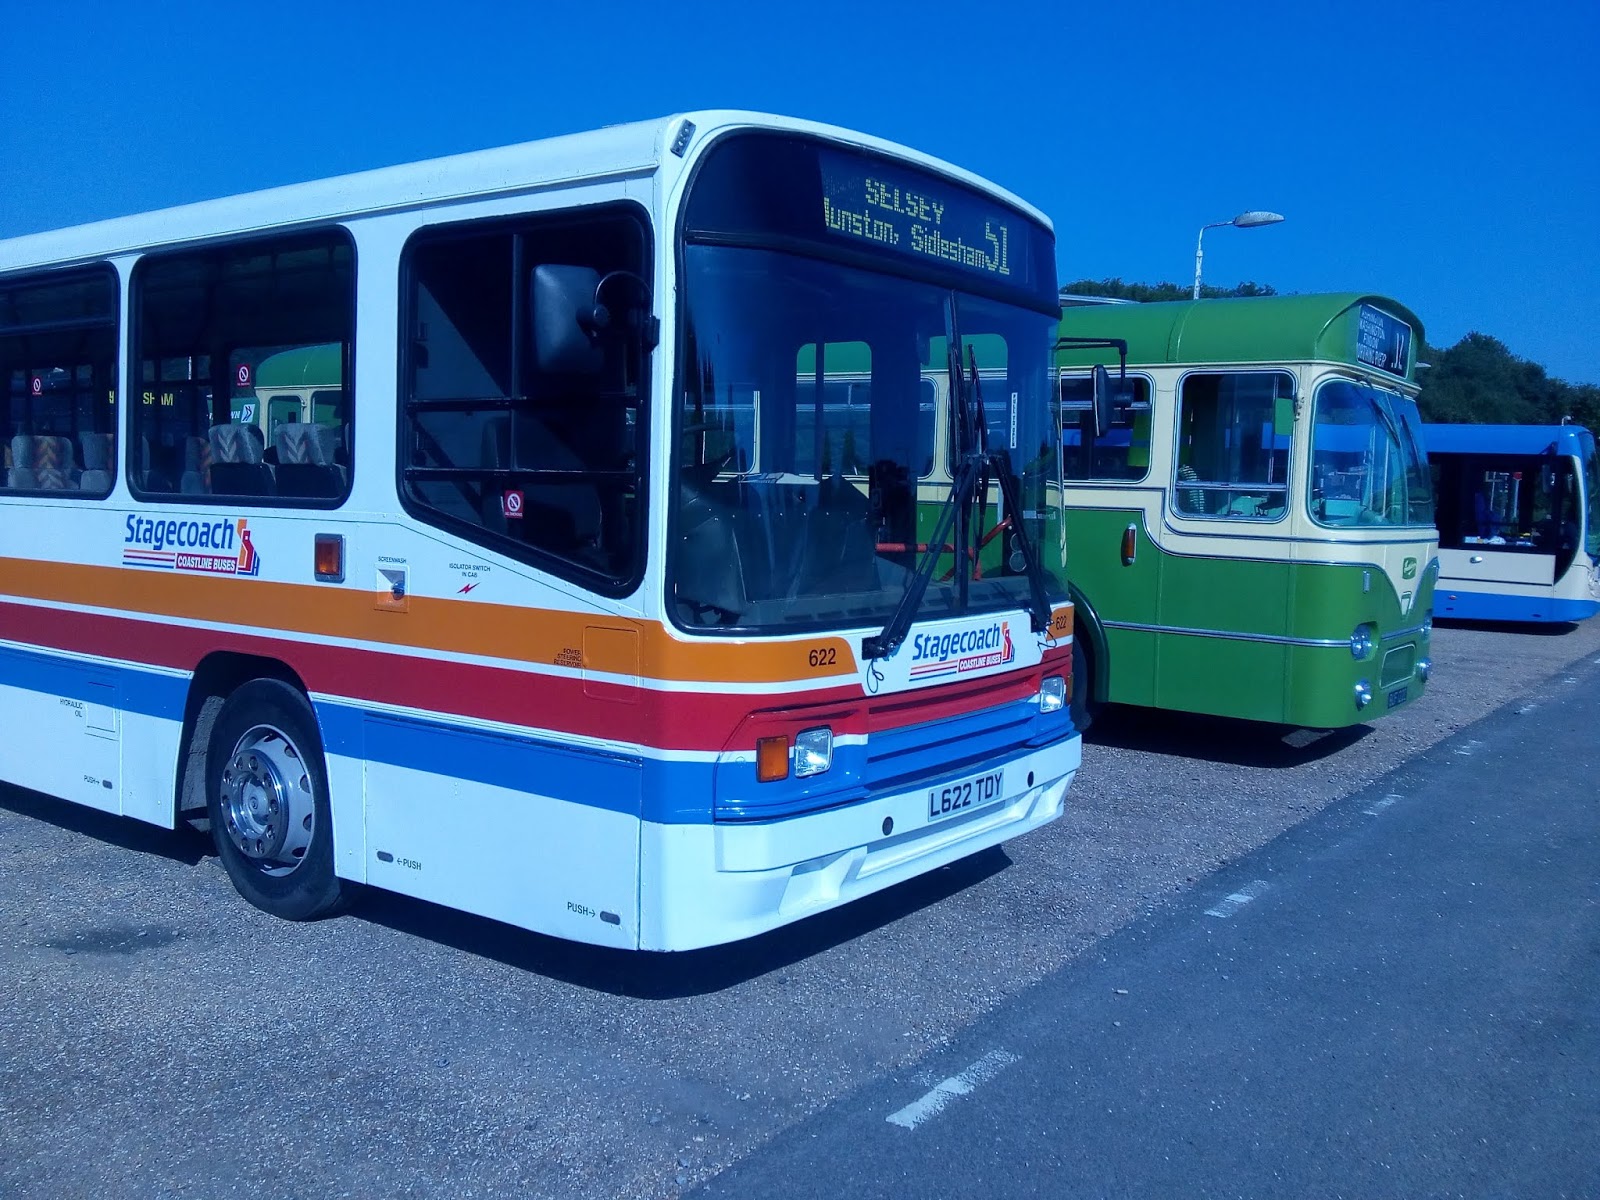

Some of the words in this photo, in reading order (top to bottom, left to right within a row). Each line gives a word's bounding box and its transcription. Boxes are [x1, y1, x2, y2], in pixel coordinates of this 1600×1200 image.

[866, 179, 944, 224] SELSEY
[911, 224, 985, 268] Sidlesham
[985, 222, 1010, 275] 51
[125, 514, 235, 550] Stagecoach
[177, 555, 212, 570] COASTLINE
[213, 558, 235, 571] BUSES
[1055, 615, 1067, 630] 622
[912, 623, 1000, 661] Stagecoach
[809, 647, 836, 667] 622
[960, 657, 986, 670] COASTLINE
[986, 654, 1001, 666] BUSES
[84, 775, 96, 784] PUSH
[930, 781, 971, 817] L622
[975, 772, 1002, 806] TDY
[402, 858, 422, 871] PUSH
[567, 901, 588, 916] PUSH
